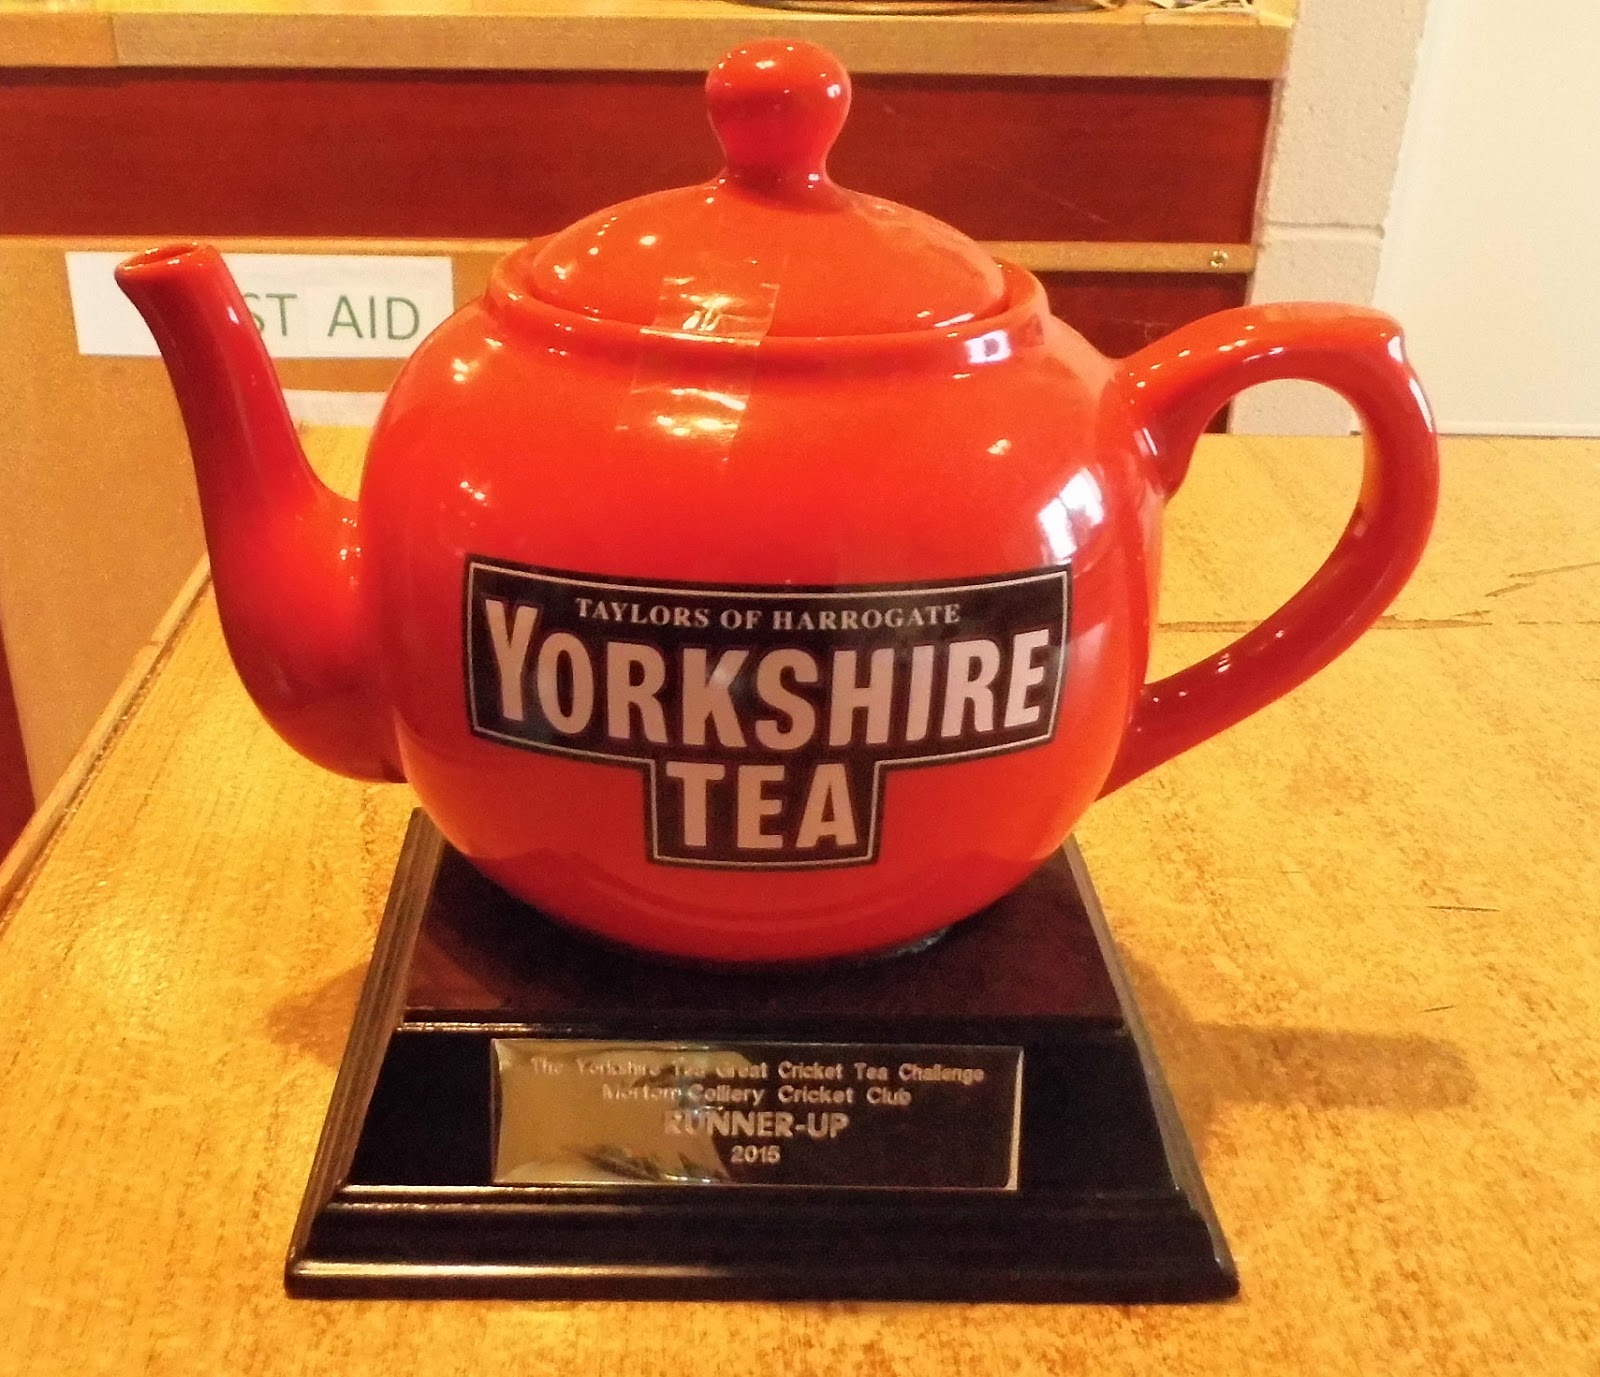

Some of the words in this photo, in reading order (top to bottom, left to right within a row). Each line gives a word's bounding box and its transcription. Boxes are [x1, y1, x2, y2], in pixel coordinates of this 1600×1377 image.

[327, 294, 421, 340] AID
[576, 597, 709, 628] TAYLORS
[720, 608, 762, 629] OF
[772, 603, 961, 631] HARROGATE
[484, 598, 1050, 751] YORKSHIRE
[666, 762, 857, 849] TEA
[530, 1057, 565, 1075] The
[716, 1061, 768, 1079] Great
[777, 1060, 843, 1080] Cricket
[854, 1062, 888, 1081] Tea
[898, 1062, 985, 1086] Challenge
[687, 1082, 765, 1106] Colliery
[777, 1084, 853, 1104] Cricket
[866, 1086, 912, 1106] Club
[664, 1109, 850, 1139] RUNNER-UP
[730, 1144, 781, 1164] 2015
